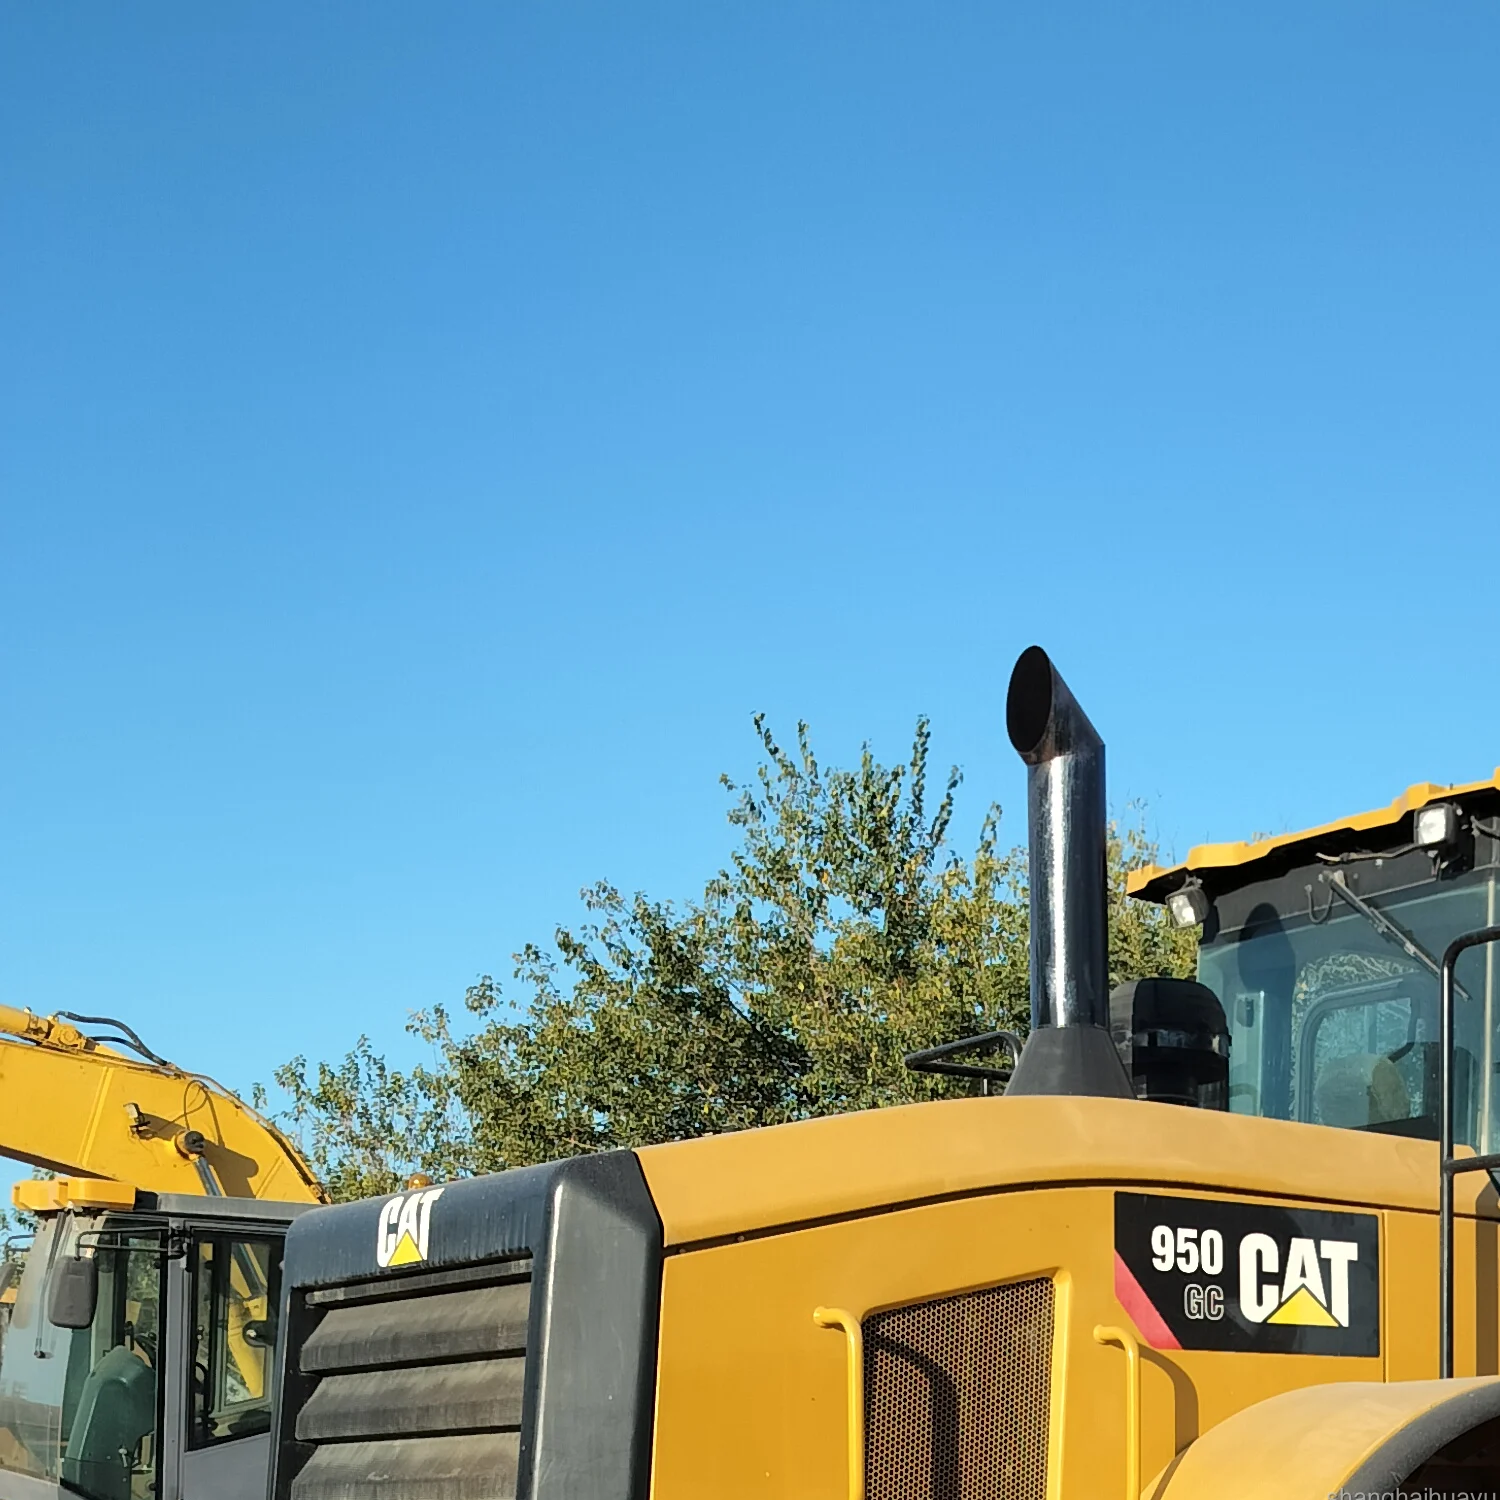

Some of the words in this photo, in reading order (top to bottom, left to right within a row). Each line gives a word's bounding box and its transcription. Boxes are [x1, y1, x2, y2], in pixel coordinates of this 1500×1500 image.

[377, 1187, 445, 1268] CAT
[1151, 1225, 1224, 1275] 950
[1184, 1284, 1225, 1321] GC
[1239, 1232, 1358, 1328] CAT
